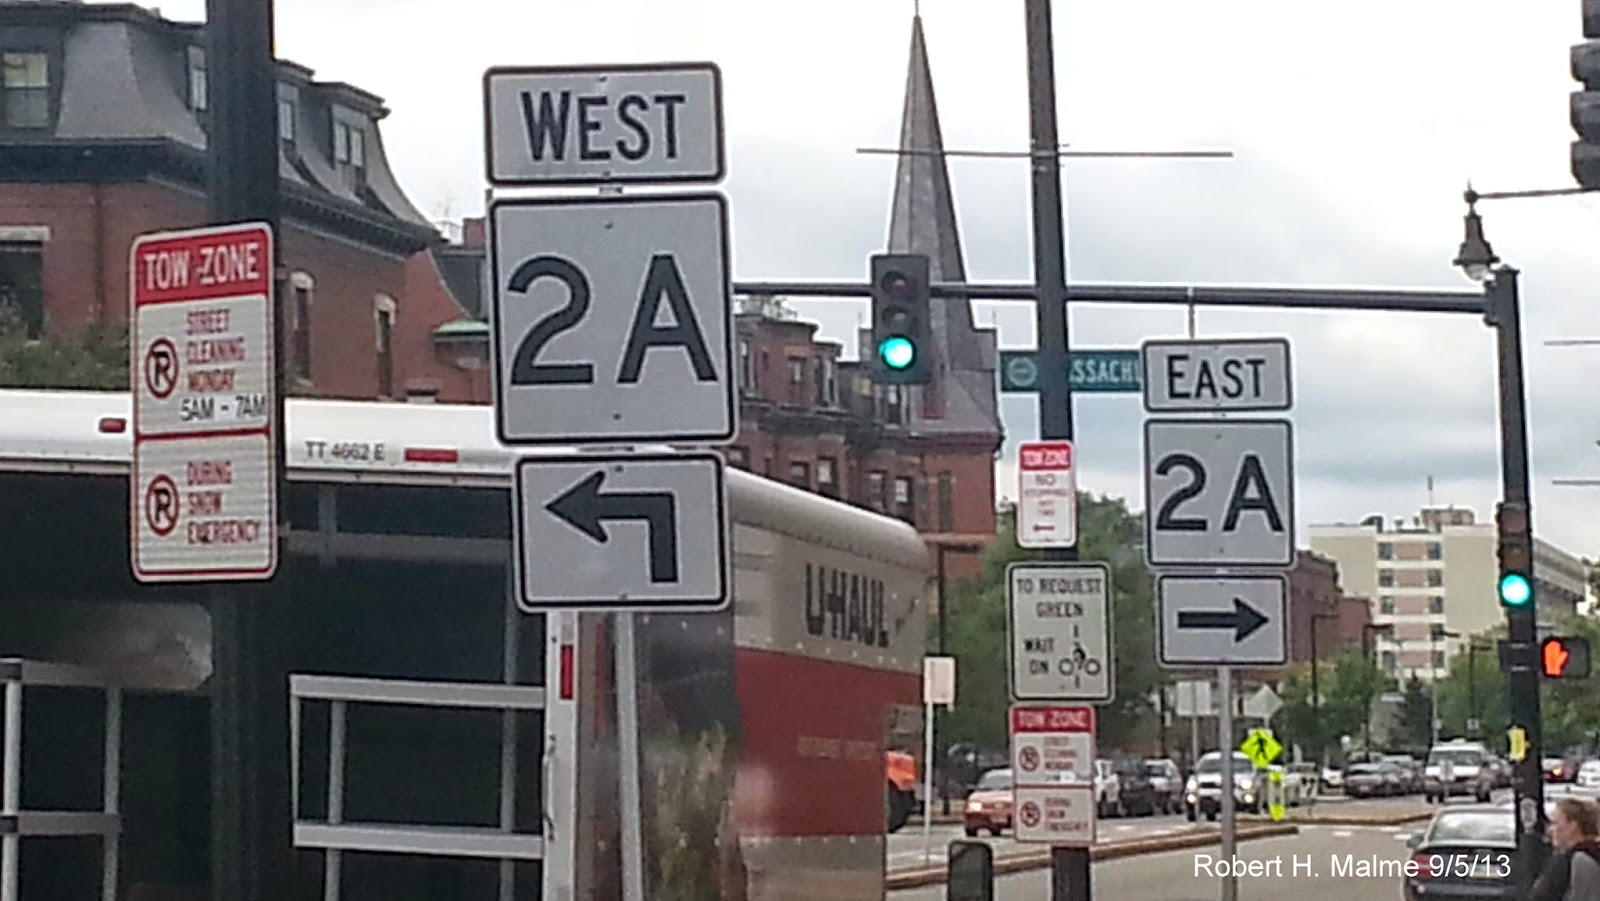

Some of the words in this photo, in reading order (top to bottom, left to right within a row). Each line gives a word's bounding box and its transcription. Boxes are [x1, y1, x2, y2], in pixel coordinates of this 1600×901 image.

[521, 91, 686, 162] WEST
[143, 251, 190, 290] TOW
[186, 309, 230, 335] STREET
[508, 255, 718, 386] 2A
[186, 337, 245, 365] CLEANING
[187, 369, 235, 393] MONDAY
[1167, 354, 1266, 399] EAST
[180, 397, 214, 421] 5AM
[235, 394, 266, 418] 7AM
[305, 441, 326, 458] TT
[376, 443, 384, 460] E
[187, 461, 231, 486] DURING
[188, 491, 222, 515] SNOW
[1155, 453, 1284, 533] 2A
[188, 520, 260, 545] EMERGENCY
[1016, 579, 1033, 593] TO
